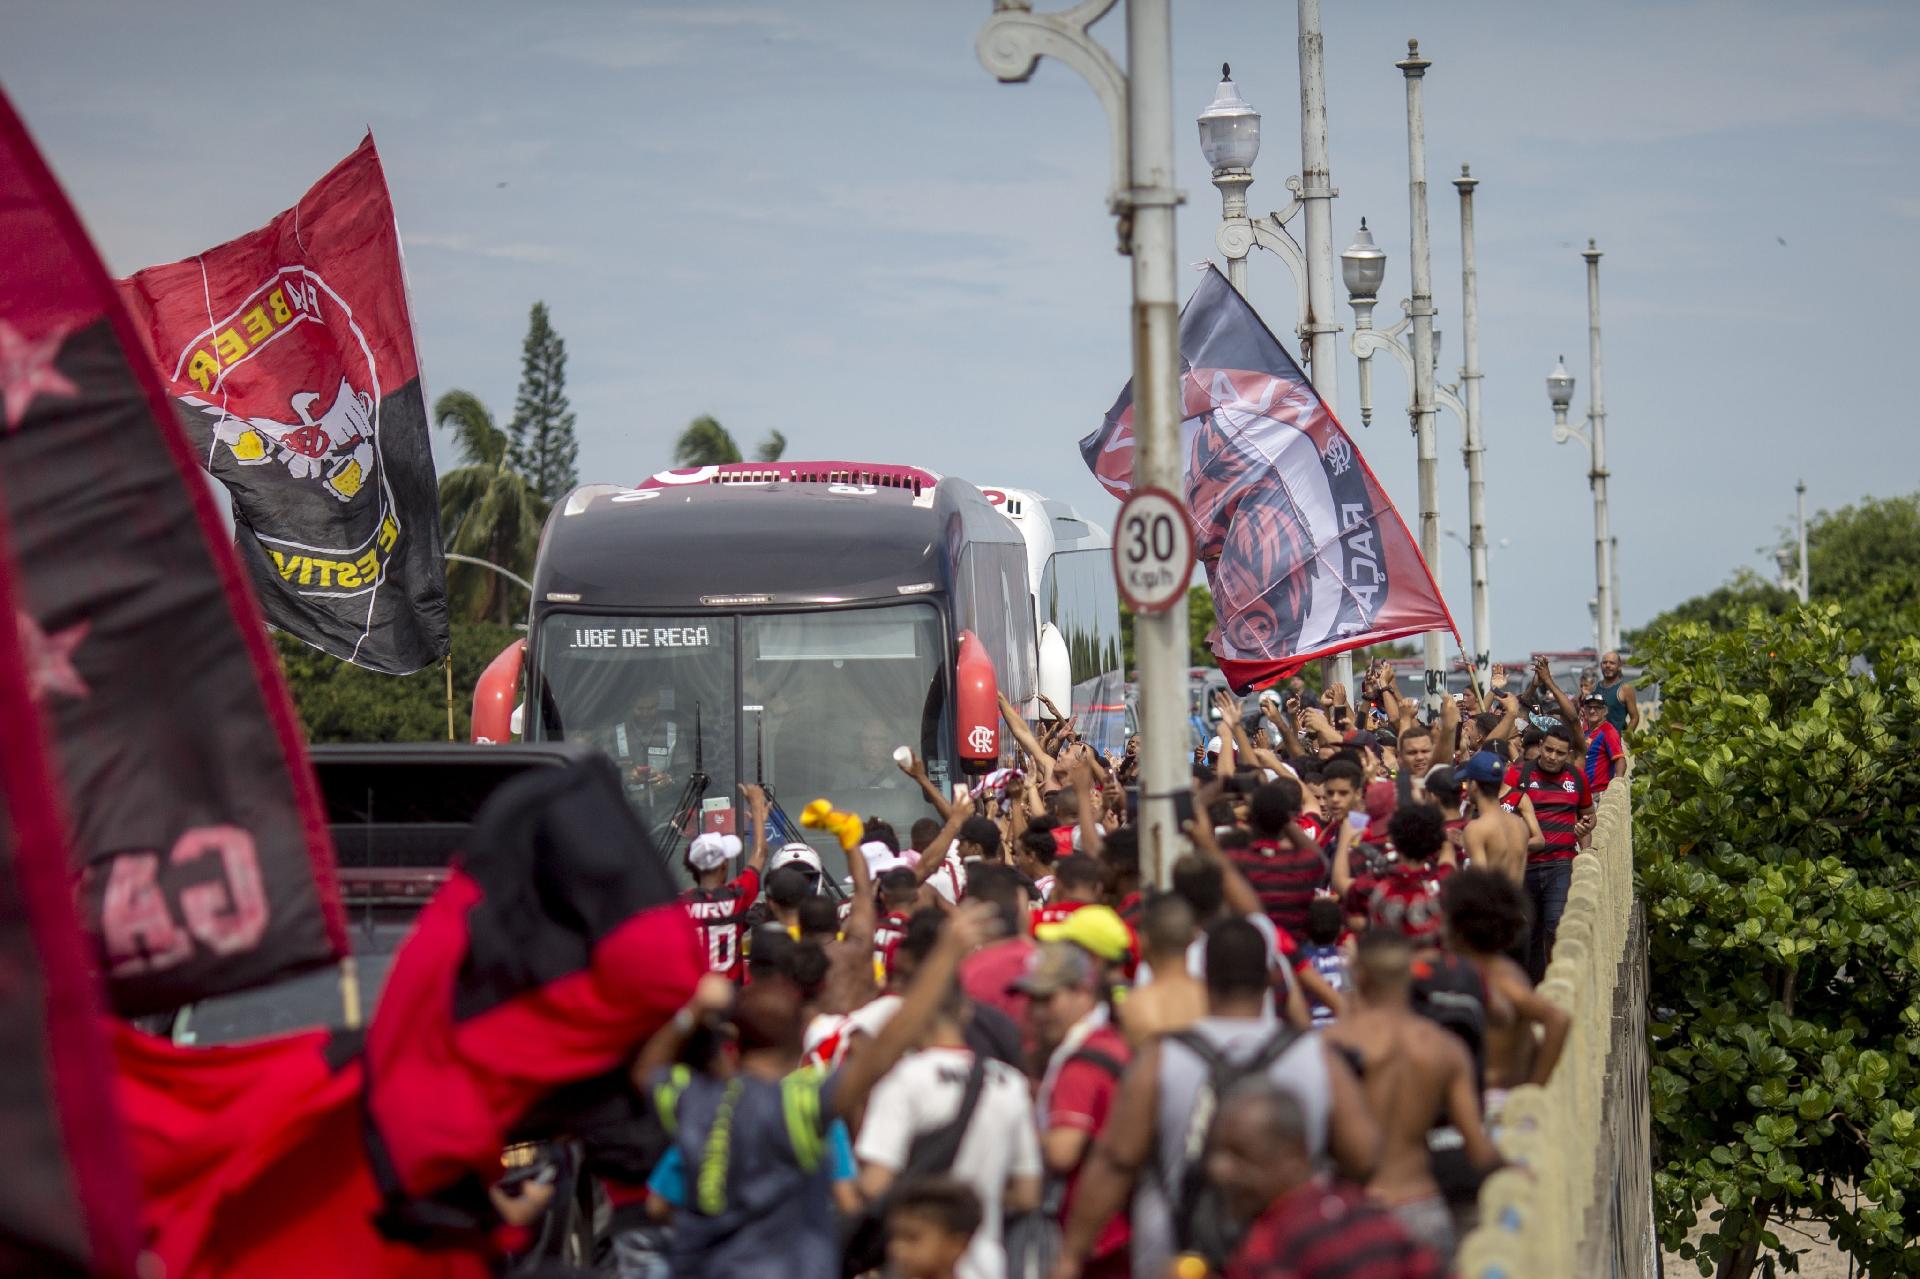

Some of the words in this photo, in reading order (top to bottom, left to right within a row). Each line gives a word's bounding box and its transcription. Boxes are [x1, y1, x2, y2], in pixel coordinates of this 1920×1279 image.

[1126, 514, 1174, 563] 30
[621, 628, 650, 648] DE
[653, 627, 709, 647] REGA
[685, 899, 736, 919] MRV
